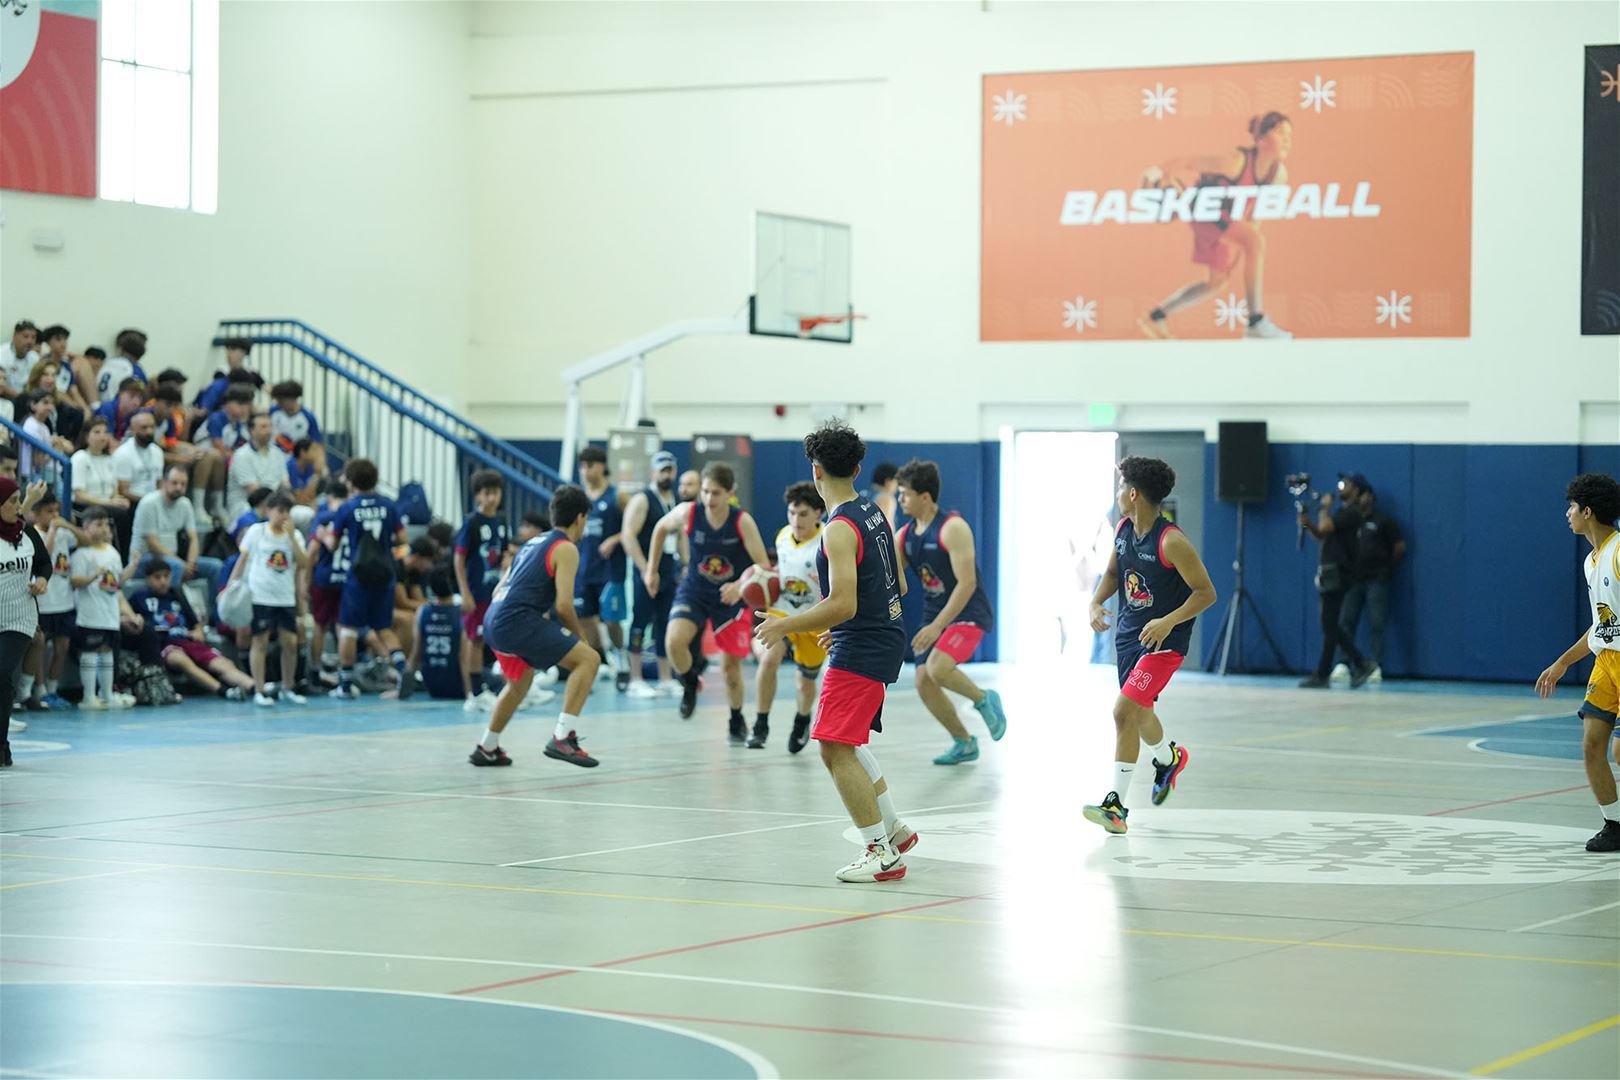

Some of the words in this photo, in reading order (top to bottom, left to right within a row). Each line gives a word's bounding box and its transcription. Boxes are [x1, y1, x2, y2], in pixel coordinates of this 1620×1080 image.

[1060, 181, 1381, 225] BASKETBALL
[99, 371, 110, 392] 8
[1128, 668, 1153, 692] 23
